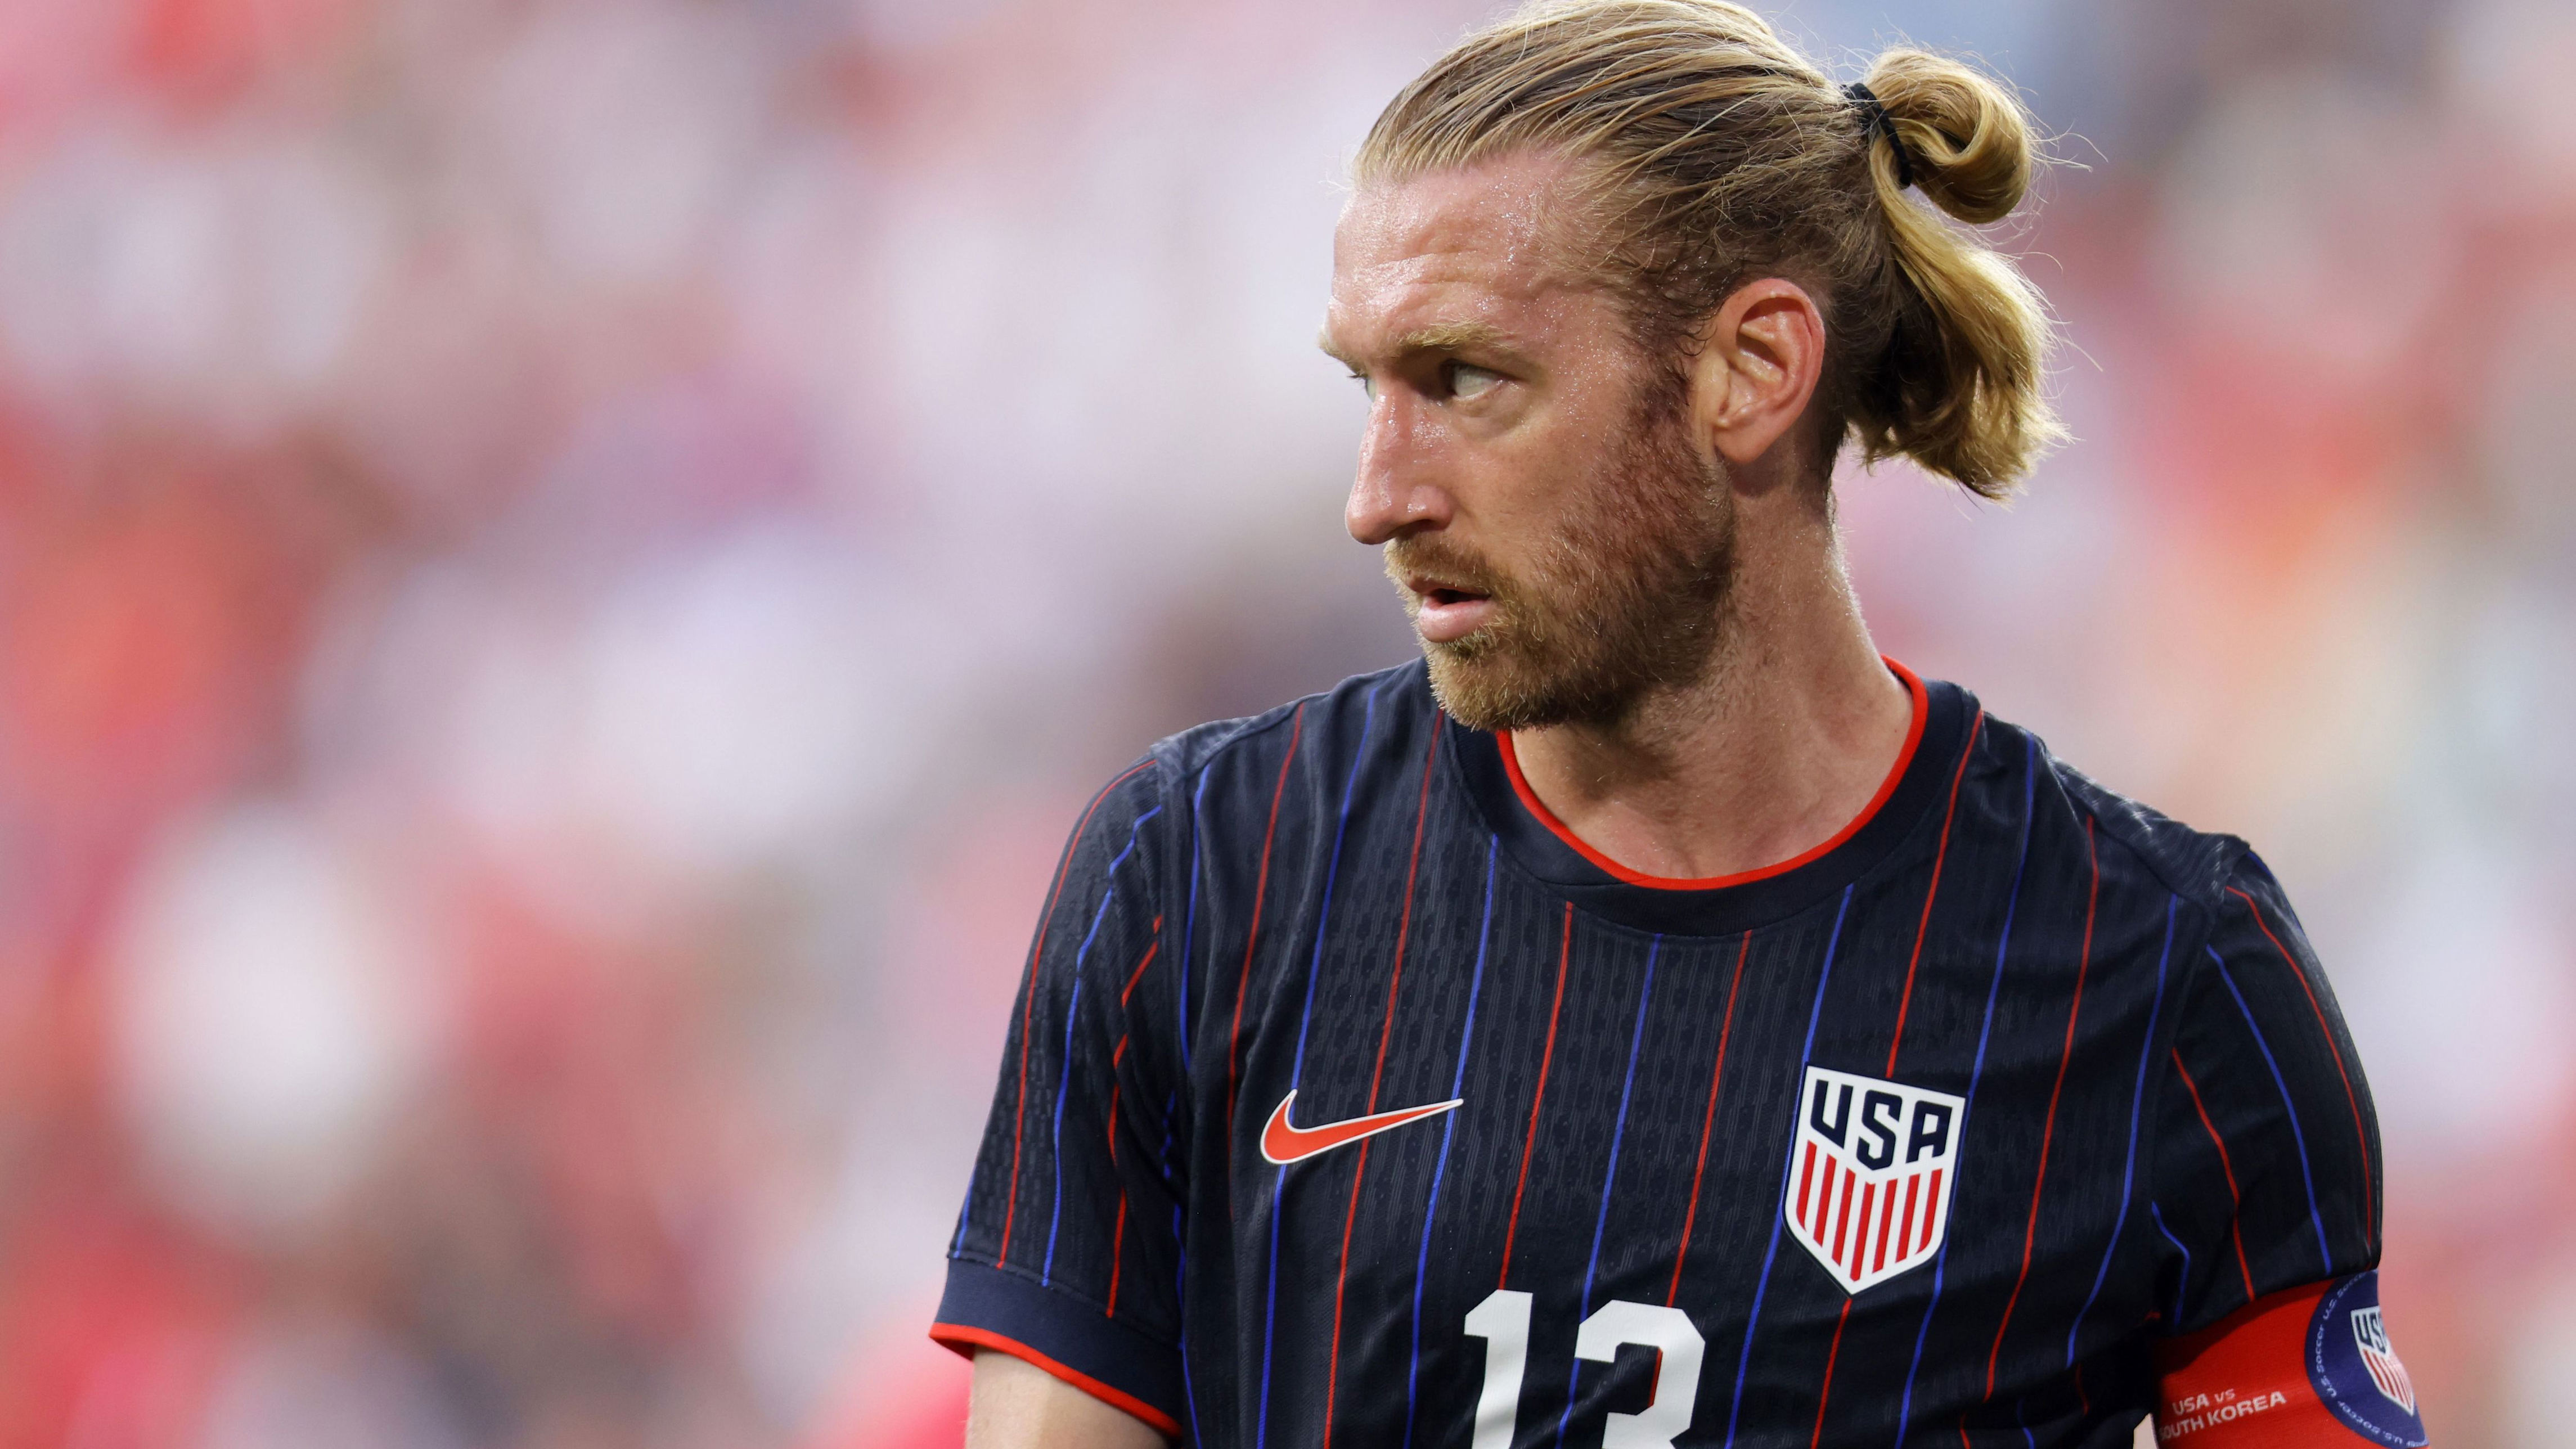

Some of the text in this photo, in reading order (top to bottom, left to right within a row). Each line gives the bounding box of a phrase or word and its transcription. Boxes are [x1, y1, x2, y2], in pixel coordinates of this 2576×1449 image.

[1810, 1079, 1953, 1171] USA
[1464, 1289, 1706, 1449] 13
[2172, 1393, 2210, 1416] USA
[2206, 1390, 2287, 1426] KOREA
